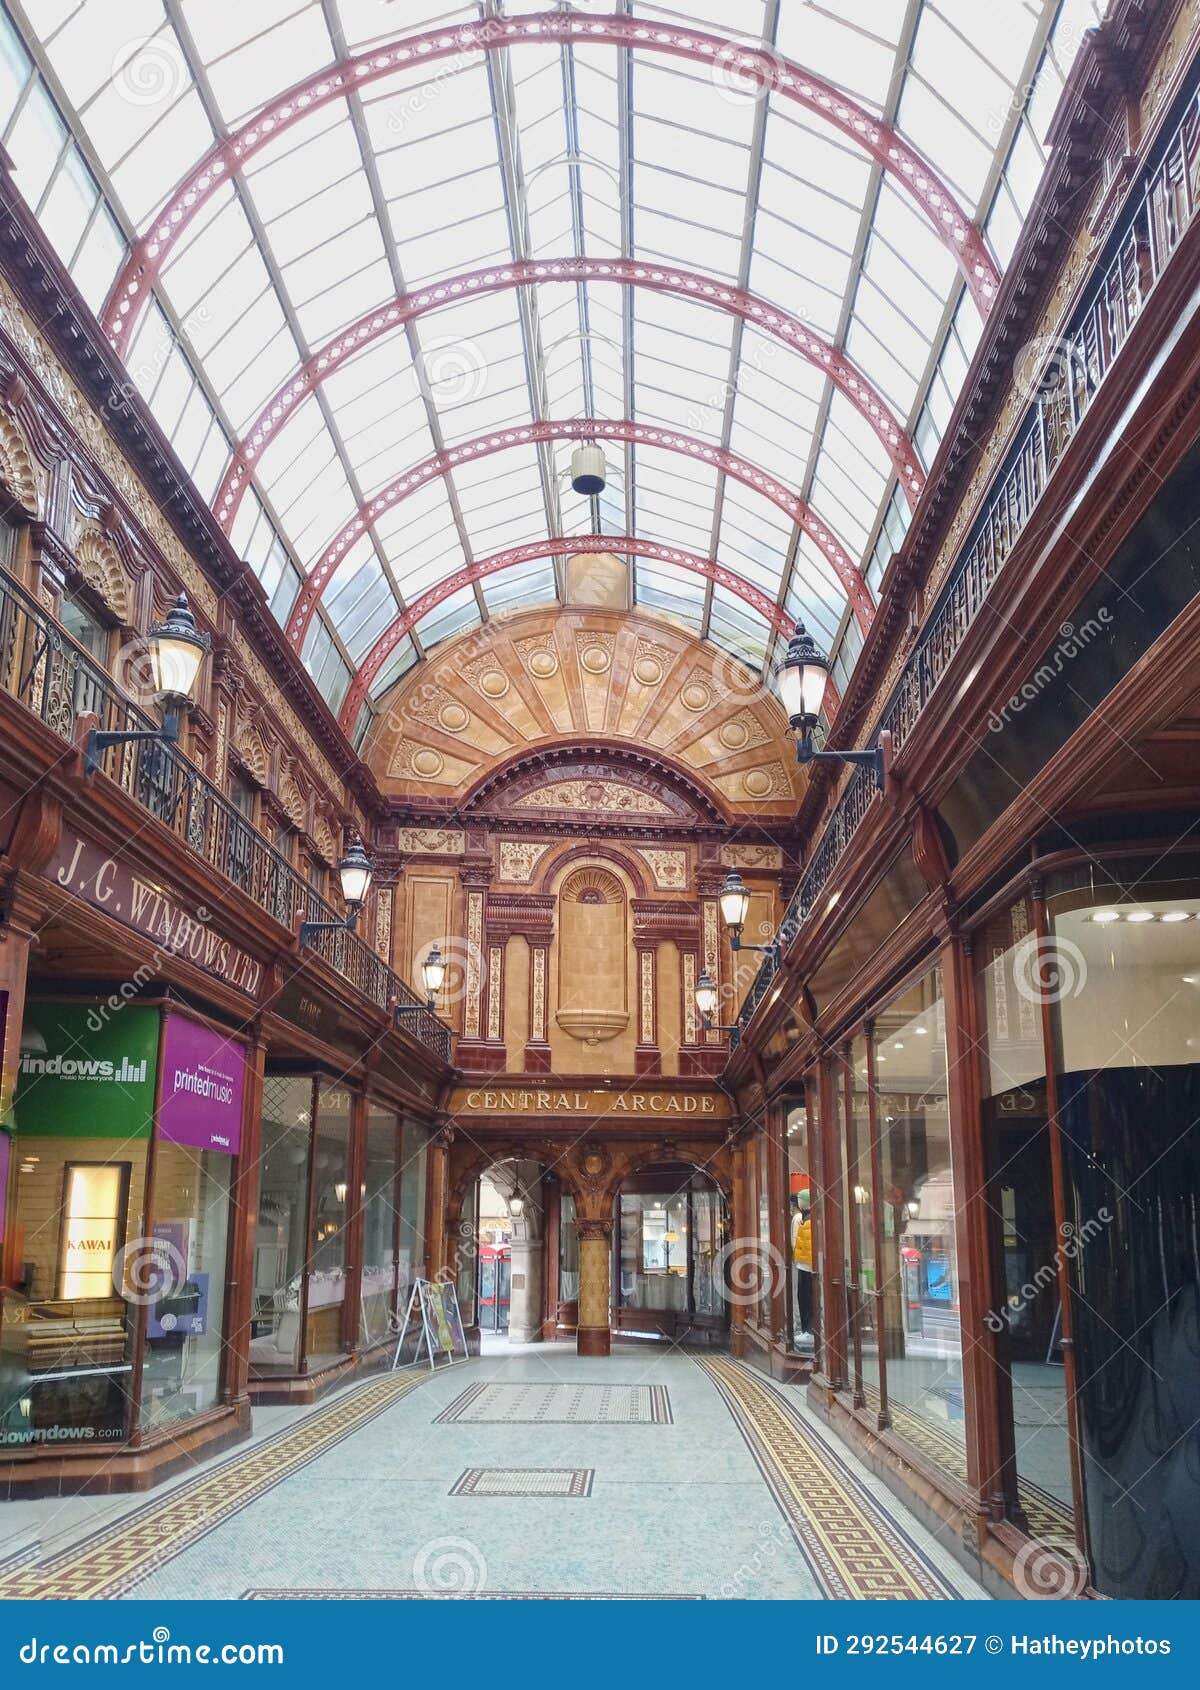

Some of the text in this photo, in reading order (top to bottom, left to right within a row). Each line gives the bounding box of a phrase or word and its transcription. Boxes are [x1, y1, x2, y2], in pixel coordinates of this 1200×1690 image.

[18, 1054, 113, 1075] indows
[466, 1092, 715, 1113] CENTRAL ARCADE
[67, 1239, 111, 1251] KAWAI
